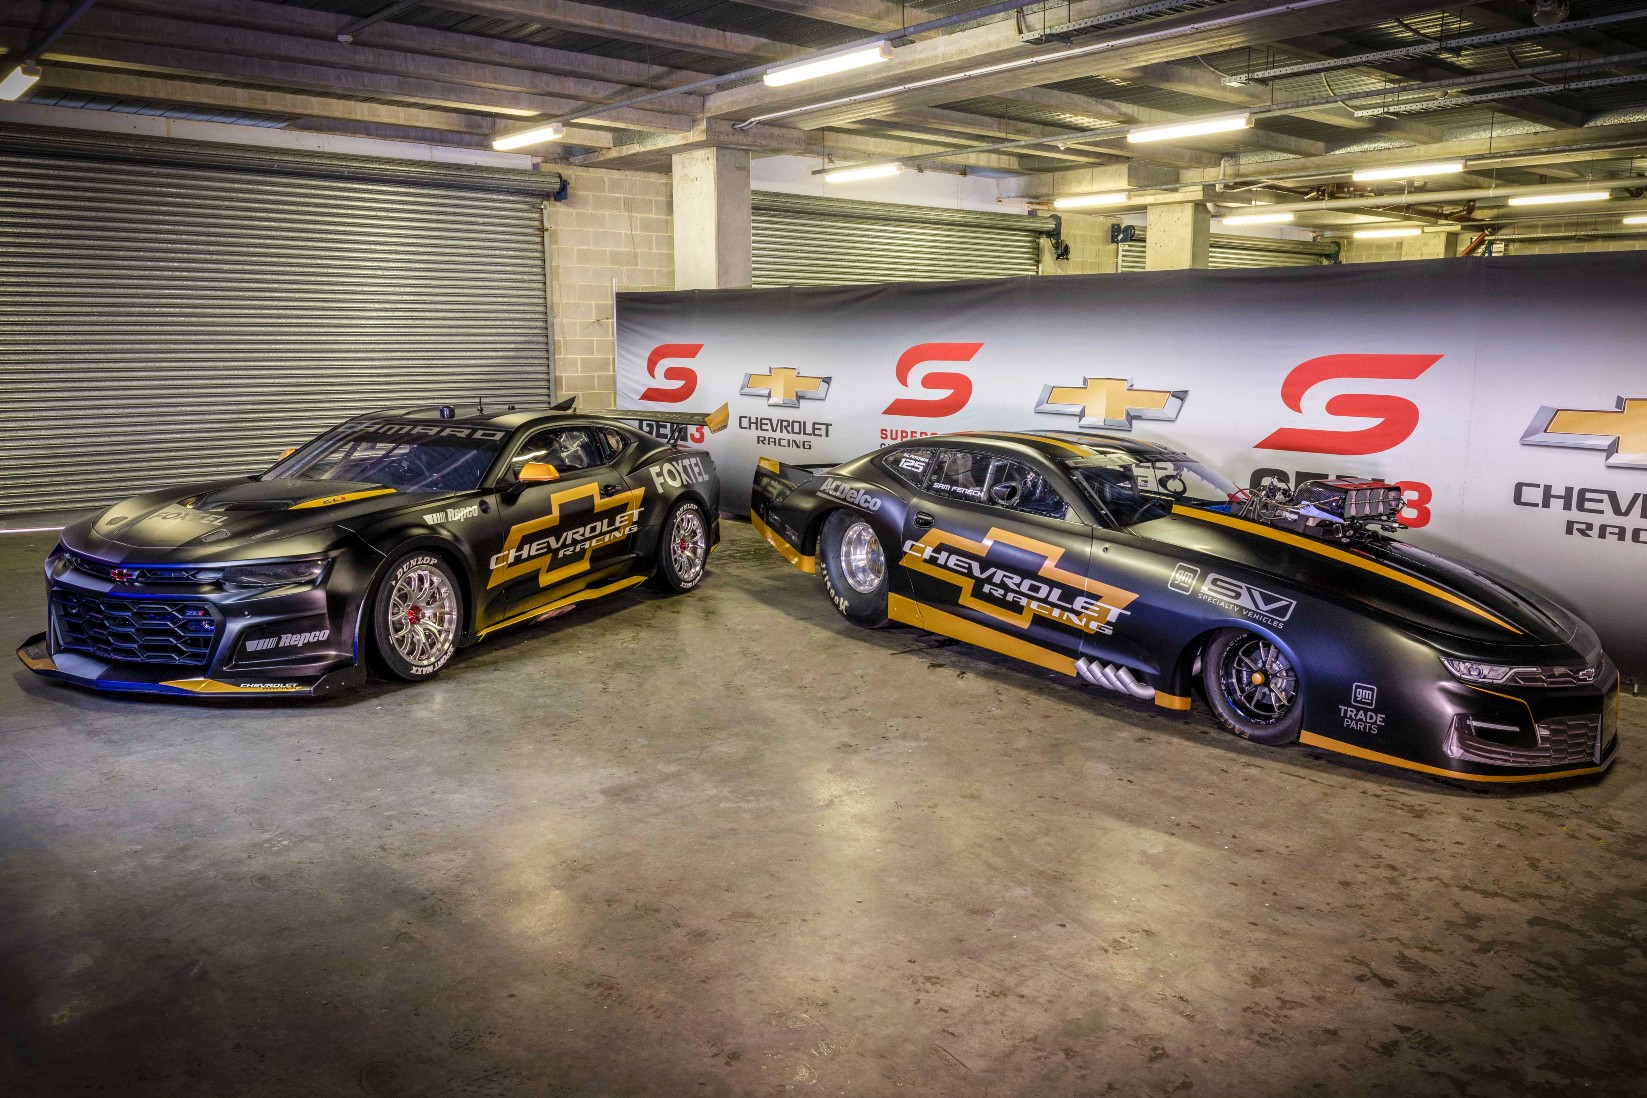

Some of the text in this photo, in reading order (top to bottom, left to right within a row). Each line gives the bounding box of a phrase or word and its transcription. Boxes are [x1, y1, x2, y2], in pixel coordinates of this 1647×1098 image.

[689, 425, 704, 444] 3
[739, 415, 832, 437] CHEVROLET
[756, 435, 812, 450] RACING
[650, 457, 709, 494] FOXTEL
[899, 458, 925, 472] 125
[819, 477, 881, 511] ACDelco
[1513, 482, 1647, 519] CHEV
[446, 505, 479, 521] Repco
[489, 508, 644, 570] CHEVROLET
[558, 525, 637, 558] RACING
[396, 556, 438, 580] DUNLOP
[902, 539, 1131, 623] CHEVROLET
[983, 583, 1114, 635] RACING
[1198, 593, 1285, 629] SPECIALTY VEHICLES
[279, 630, 330, 647] Repco
[1356, 688, 1372, 701] gm
[1339, 705, 1386, 726] TRADE
[1344, 719, 1378, 734] PARTS
